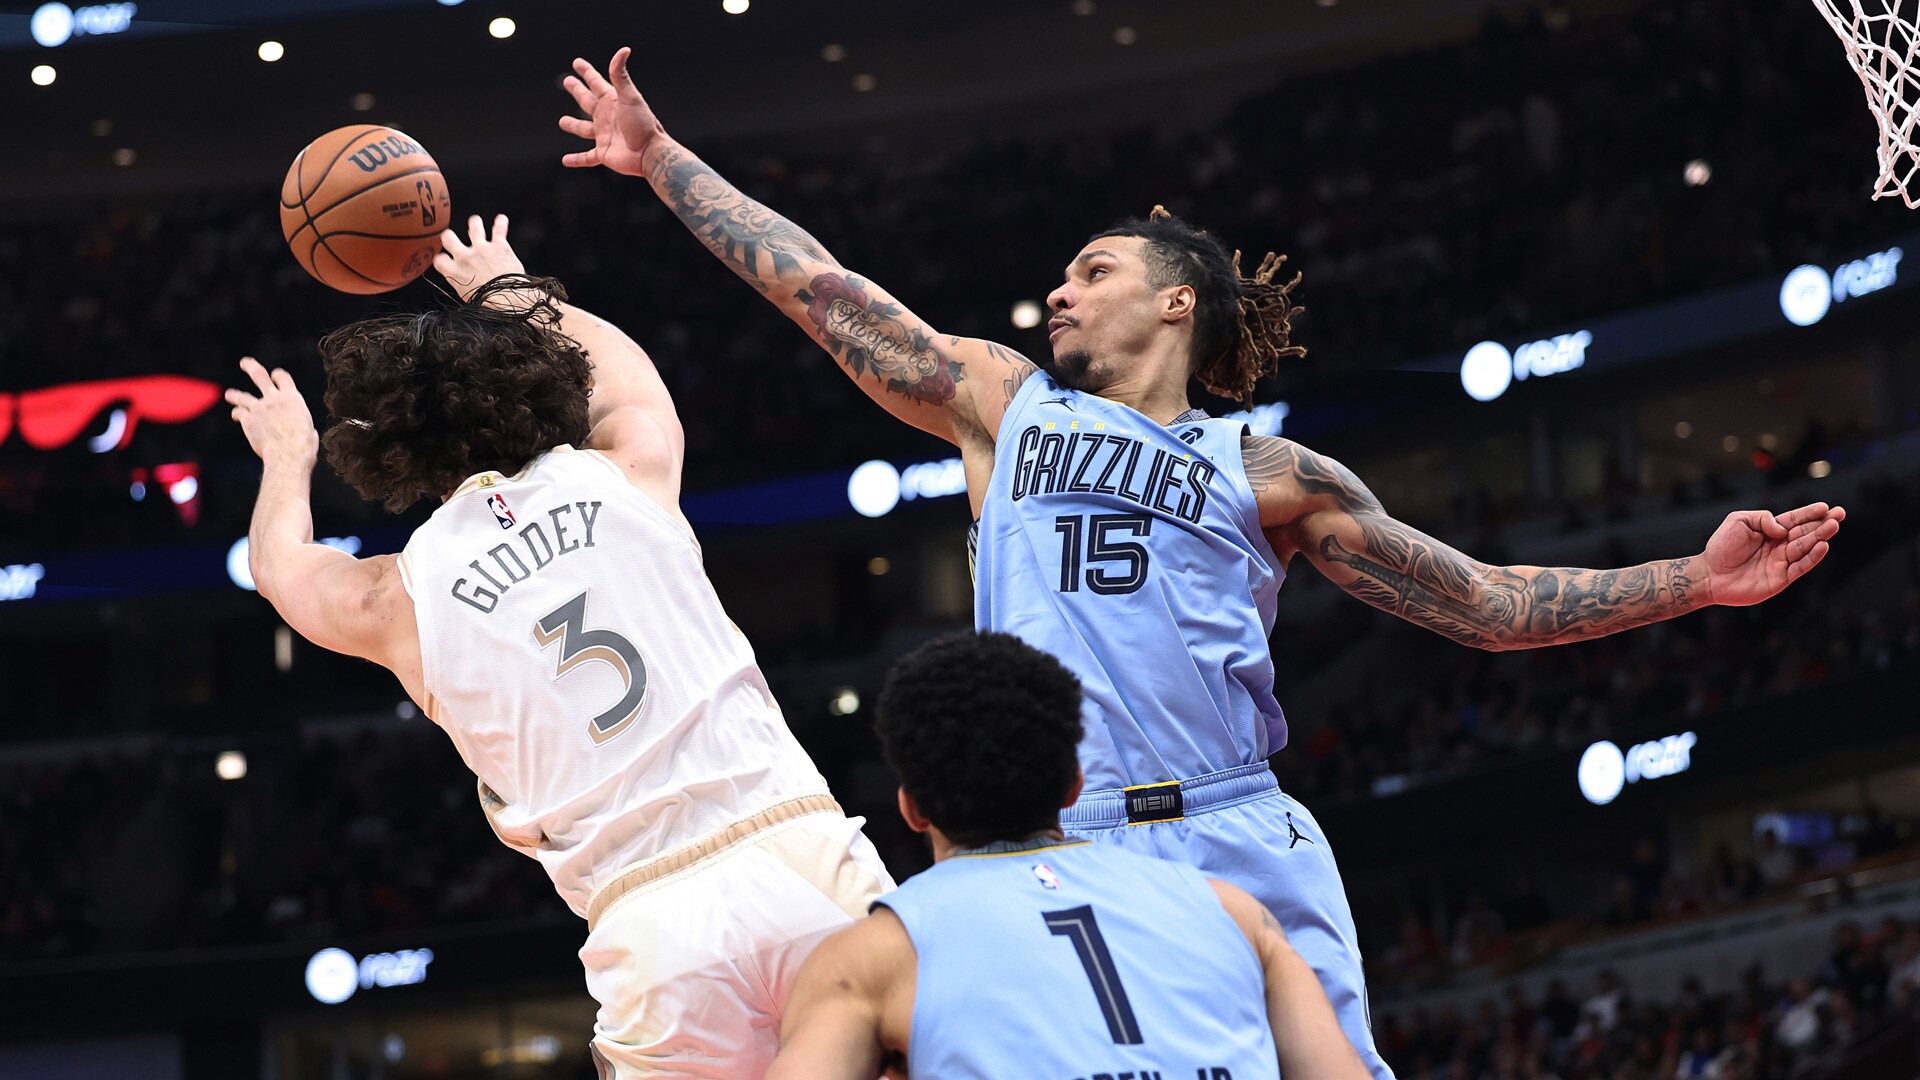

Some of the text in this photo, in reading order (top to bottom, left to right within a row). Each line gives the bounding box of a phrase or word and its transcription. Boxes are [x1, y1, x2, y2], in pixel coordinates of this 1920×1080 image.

[348, 136, 427, 172] Wils
[1012, 425, 1216, 525] GRIZZLIES
[452, 501, 601, 613] GIDDEY
[1055, 514, 1152, 594] 15
[531, 589, 647, 748] 3
[1041, 904, 1144, 1045] 1
